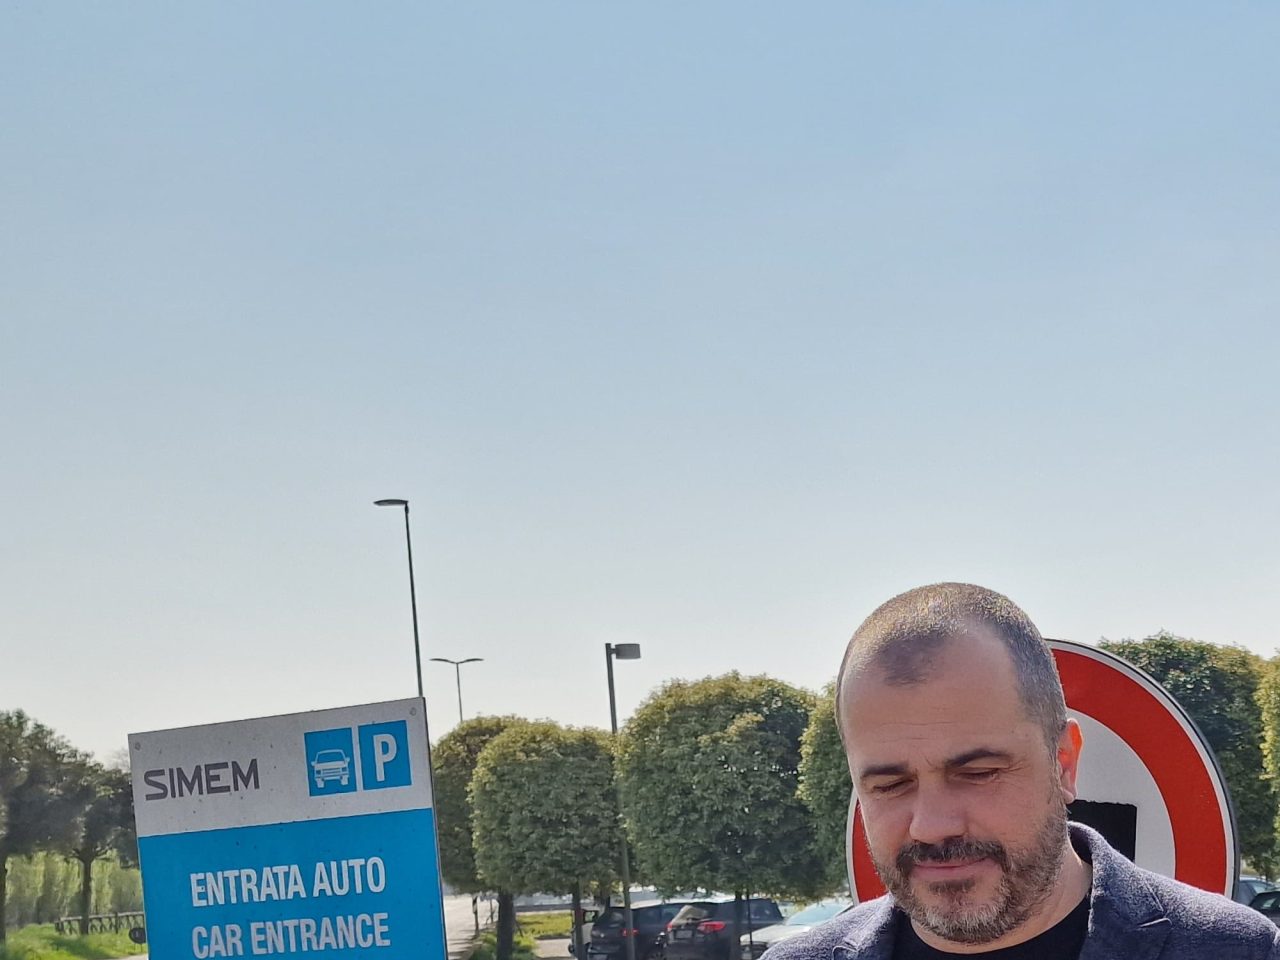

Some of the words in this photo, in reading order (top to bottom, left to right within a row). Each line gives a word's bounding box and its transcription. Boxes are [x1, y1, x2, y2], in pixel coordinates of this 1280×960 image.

[143, 758, 260, 801] SIMEM
[372, 733, 397, 781] P
[190, 864, 306, 907] ENTRATA
[313, 857, 386, 897] AUTO
[192, 923, 243, 959] CAR
[250, 913, 391, 955] ENTRANCE
